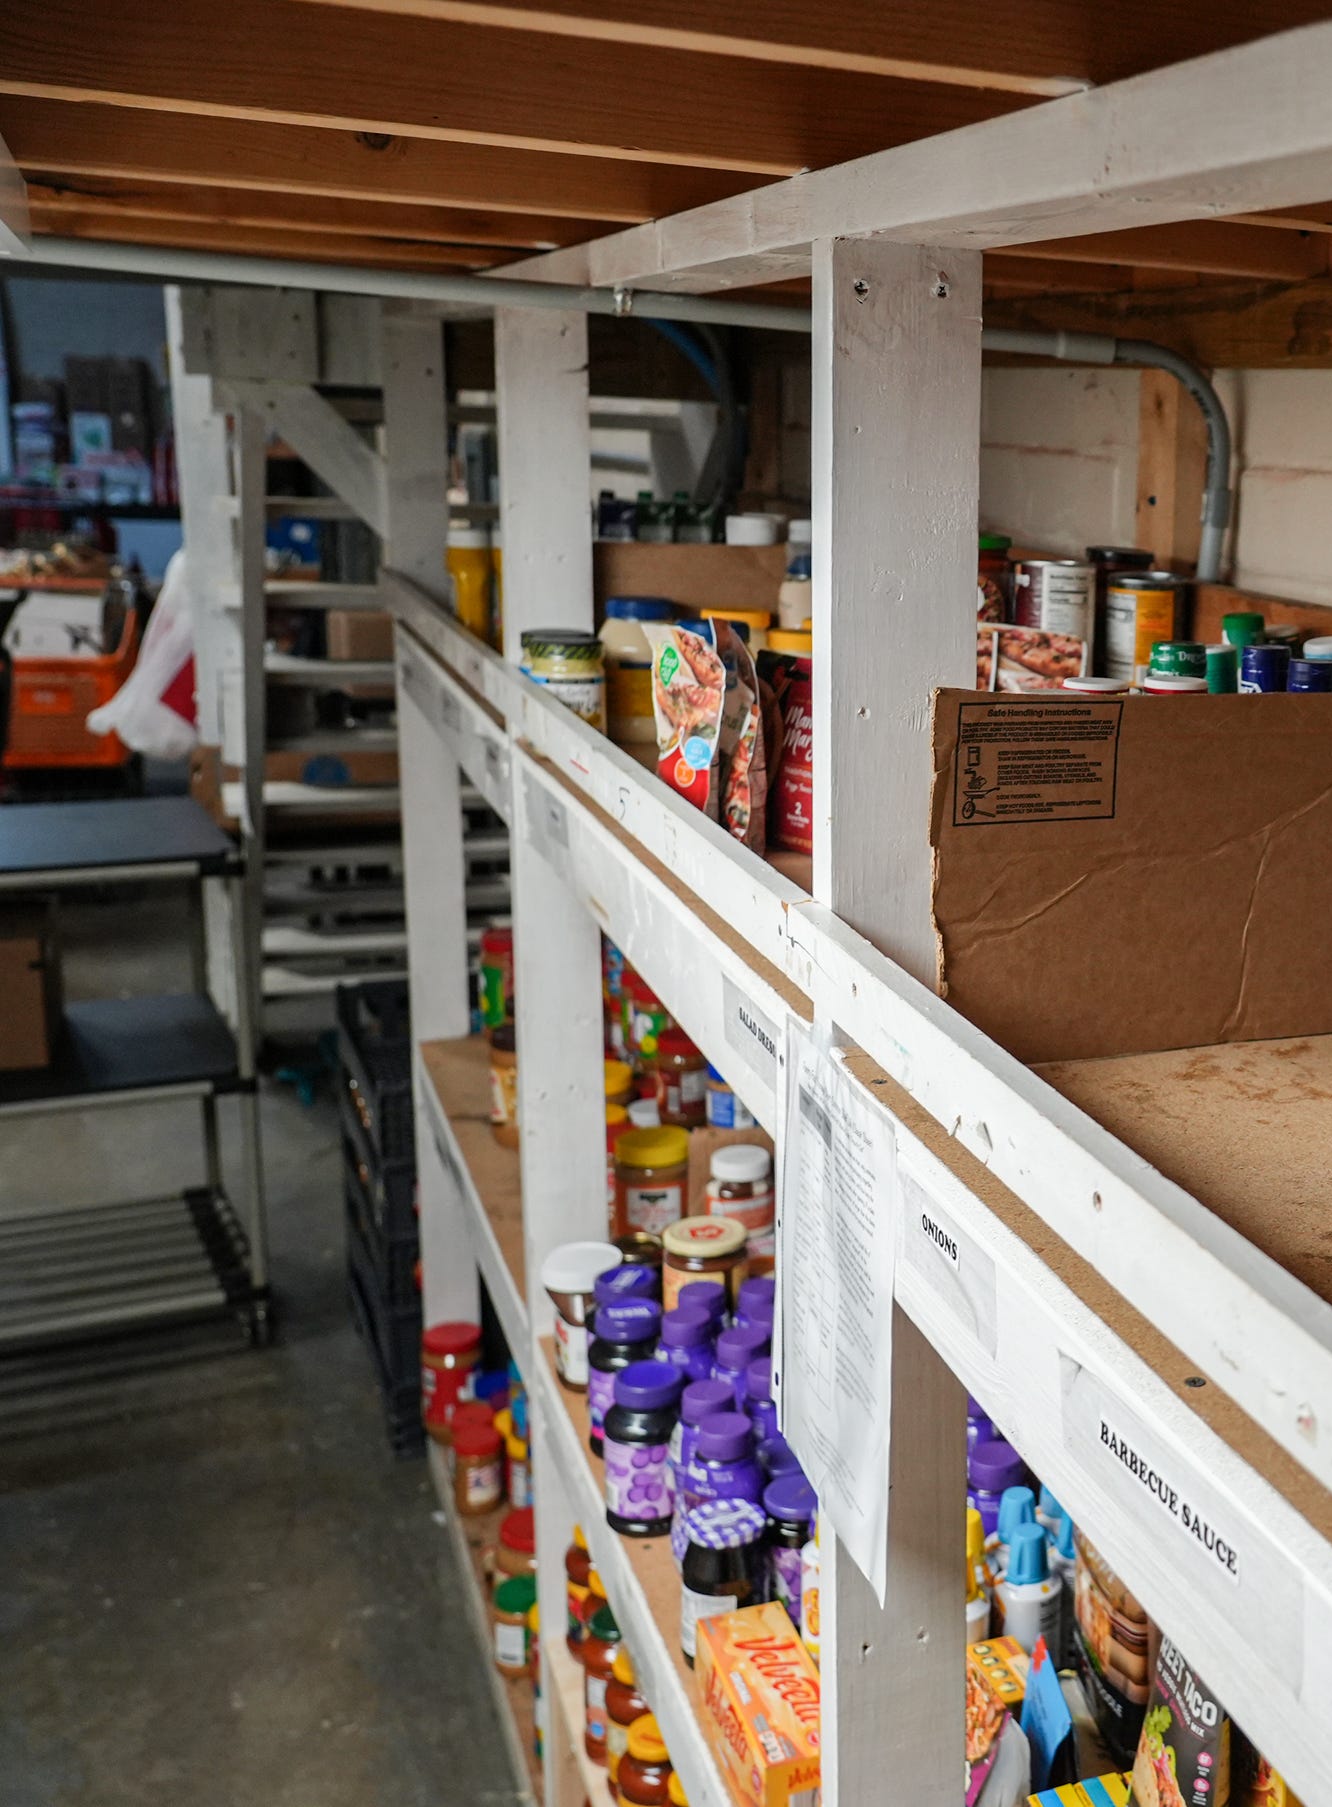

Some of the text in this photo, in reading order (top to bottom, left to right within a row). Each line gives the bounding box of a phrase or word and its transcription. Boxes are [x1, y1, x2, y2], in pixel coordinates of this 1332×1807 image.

[987, 708, 1092, 718] Safe Handling Instructions
[739, 1006, 757, 1036] SALAD
[921, 1213, 958, 1261] ONIONS
[1099, 1420, 1239, 1575] BARBECUE SAUCE
[1184, 1670, 1219, 1727] TACO
